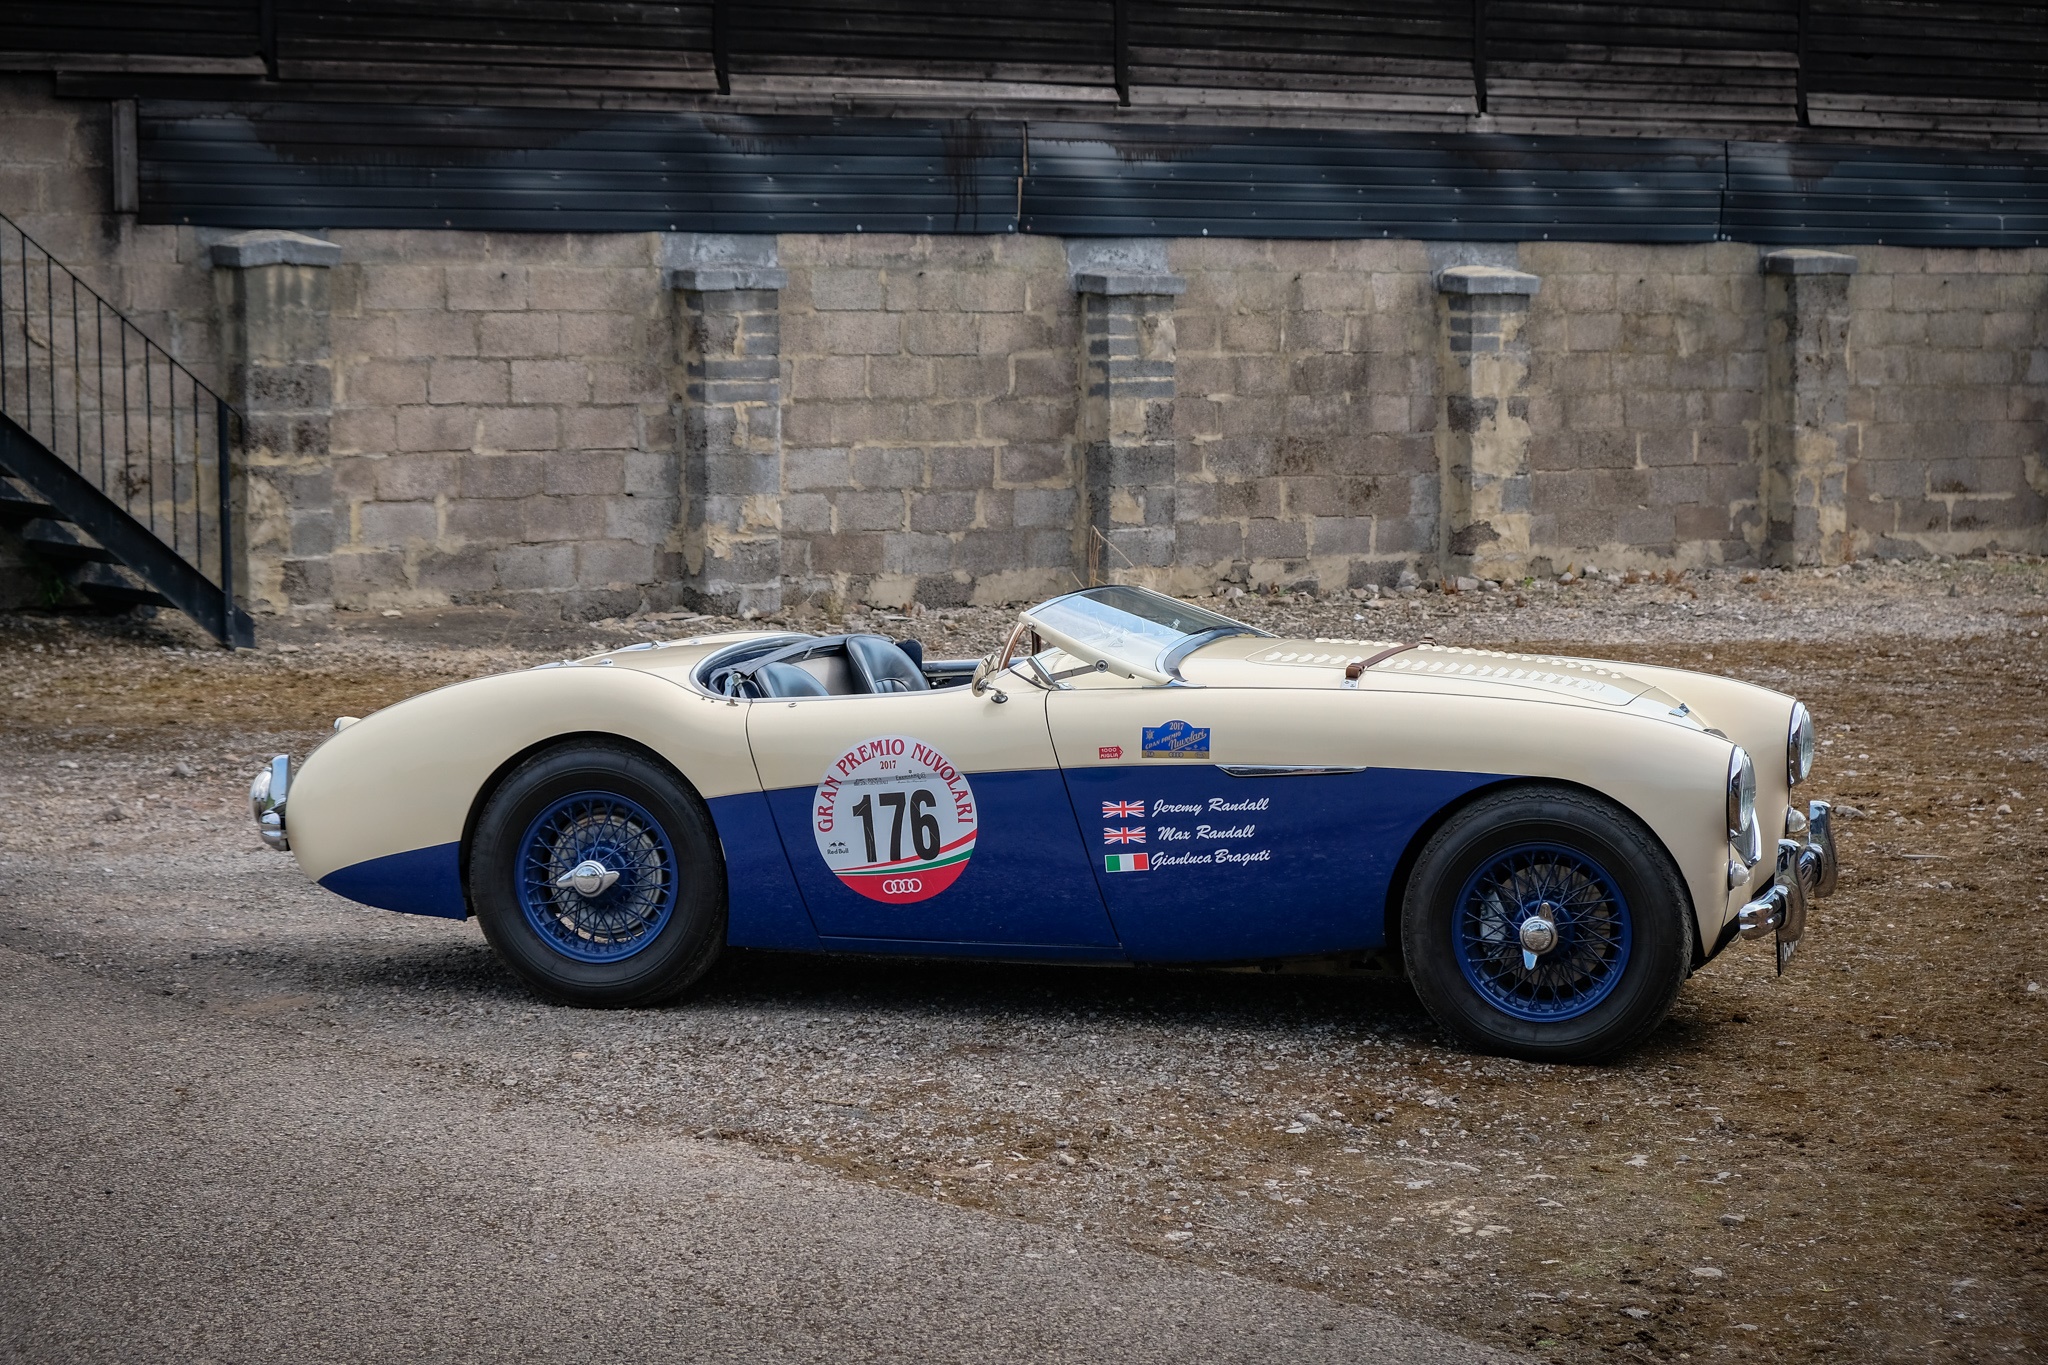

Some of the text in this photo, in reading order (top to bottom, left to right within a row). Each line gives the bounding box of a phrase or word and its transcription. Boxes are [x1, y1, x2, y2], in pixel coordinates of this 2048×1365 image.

[1169, 721, 1185, 731] 2017
[1168, 728, 1207, 751] Nuvolari
[879, 760, 897, 770] 2017
[817, 738, 974, 833] GRAN PREMIO NUVOLARI
[1151, 797, 1270, 818] Jeremy Randall
[852, 789, 941, 863] 176
[1157, 824, 1256, 842] Max Randall
[1151, 849, 1271, 871] Gianluca Braguti
